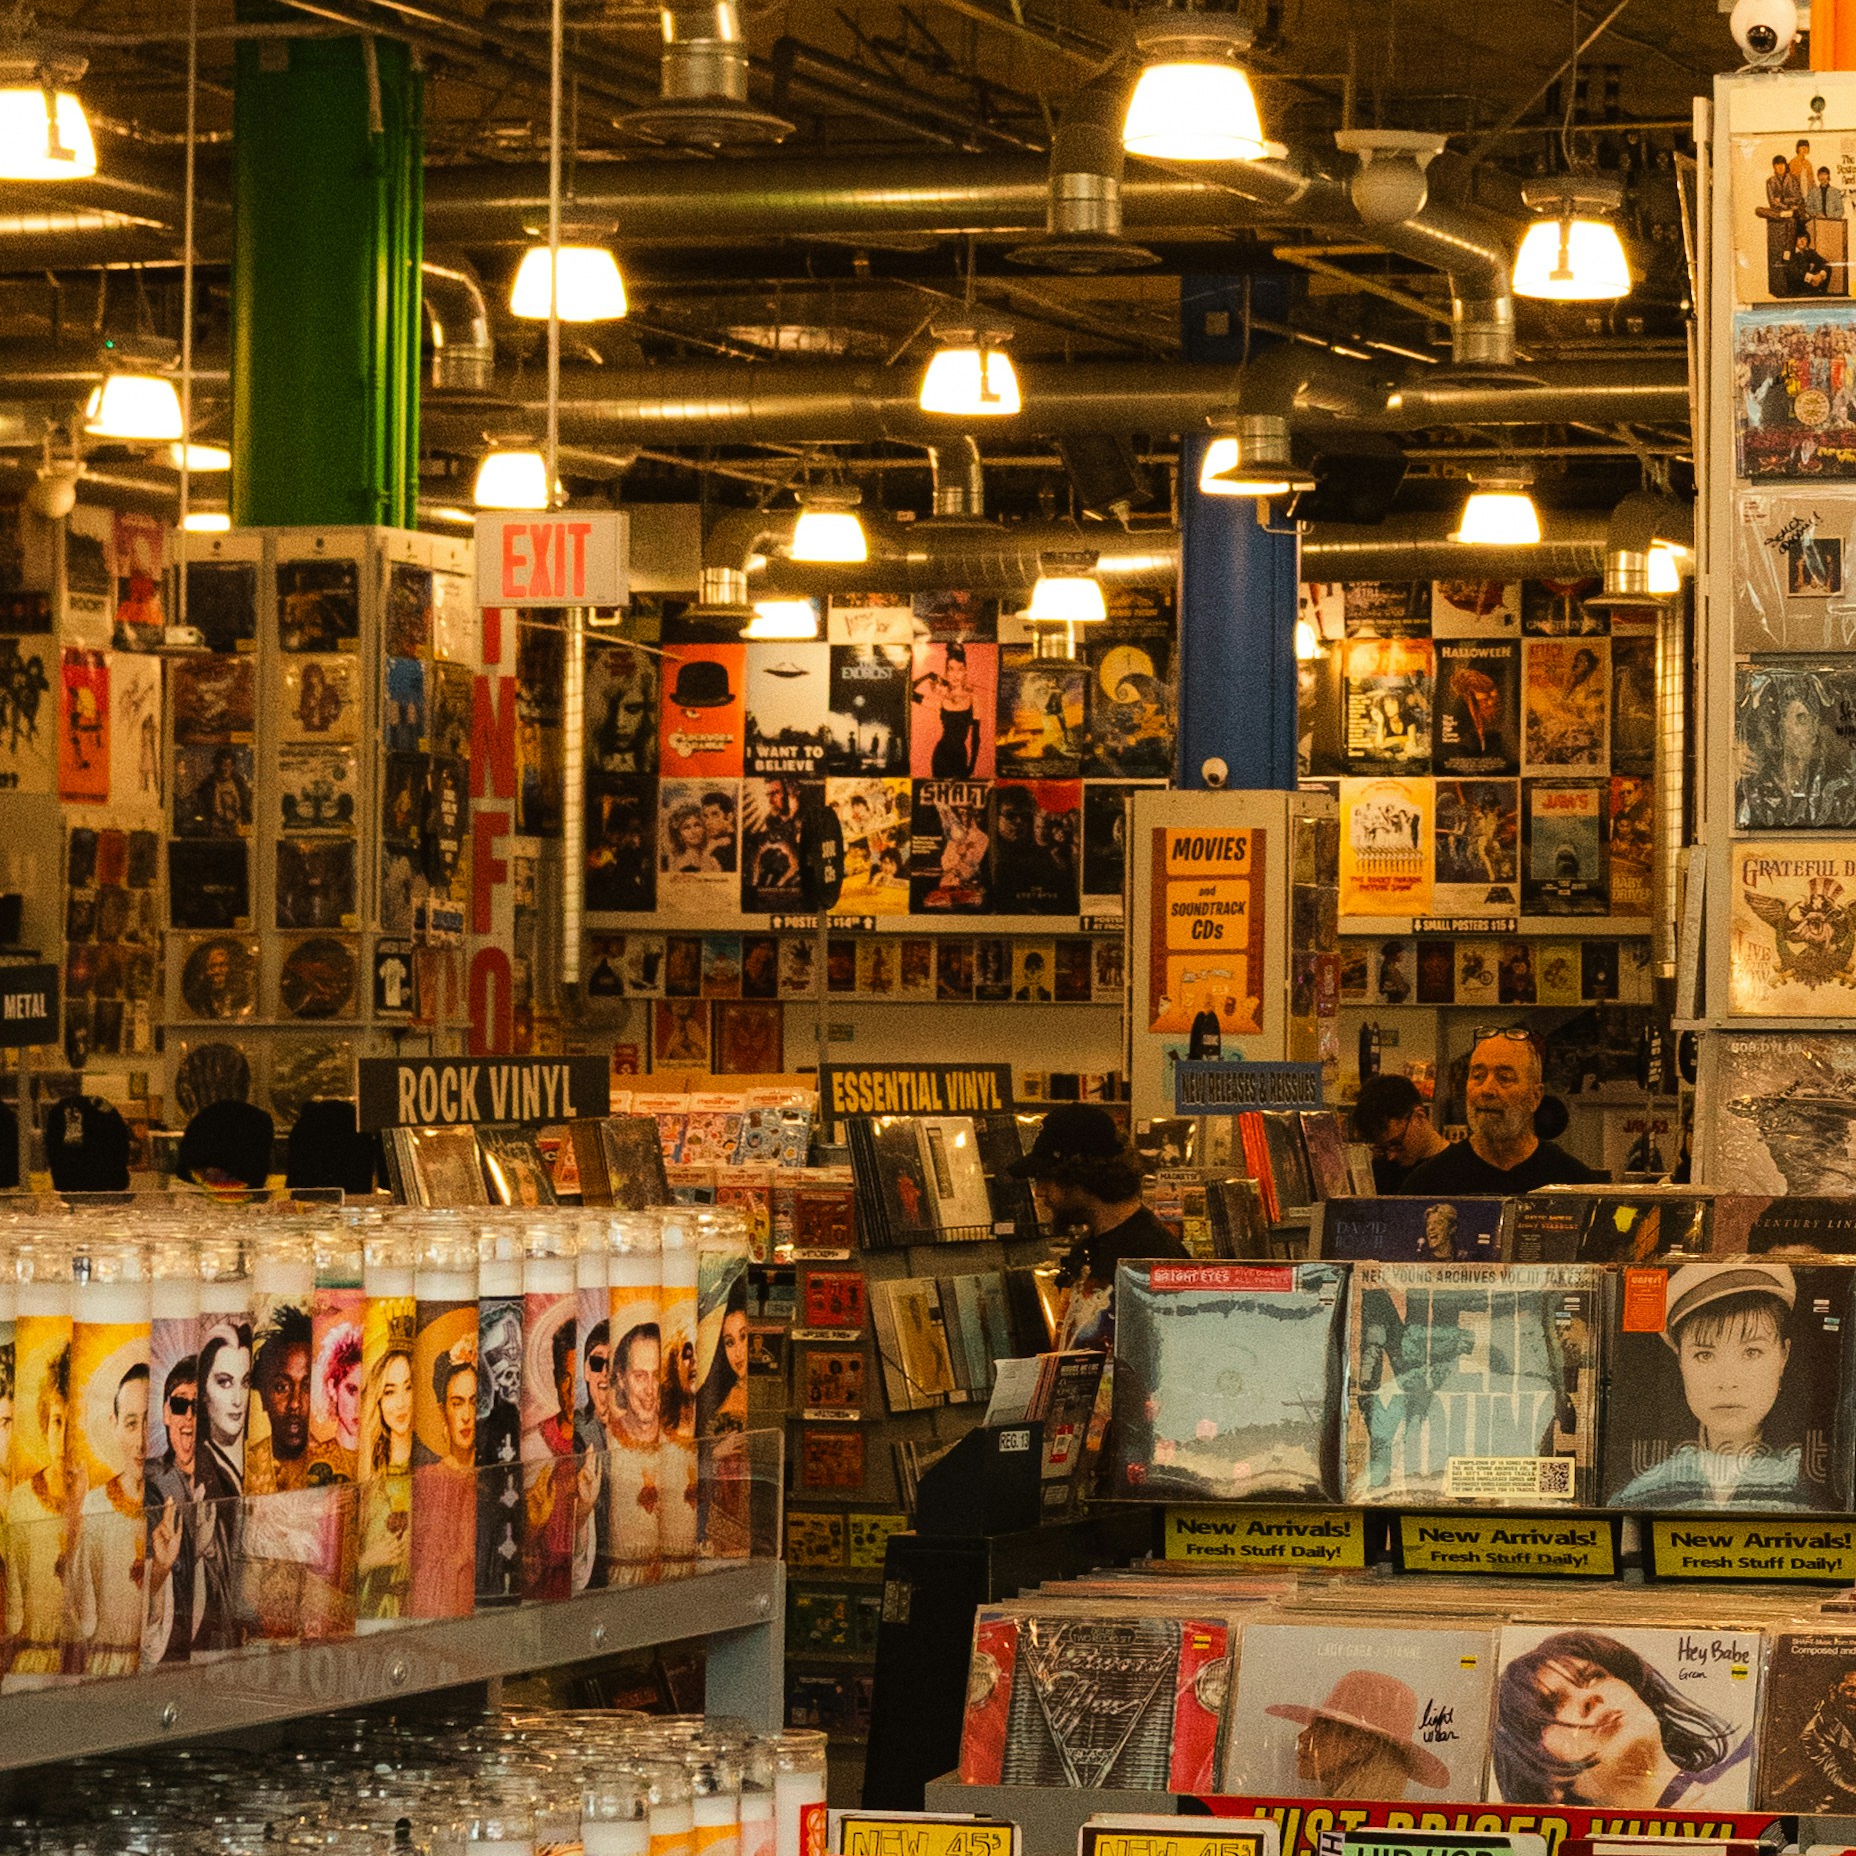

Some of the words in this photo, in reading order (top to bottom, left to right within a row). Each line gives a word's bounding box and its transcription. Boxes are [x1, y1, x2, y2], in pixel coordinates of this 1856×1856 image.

[502, 522, 592, 598] EXIT
[1441, 646, 1513, 659] HALLOWEEN
[755, 746, 798, 758] WANT
[803, 746, 824, 758] TO
[755, 759, 815, 772] BELIEVE
[920, 782, 989, 806] SHAFT
[1540, 794, 1590, 810] JAWS
[1172, 836, 1247, 862] MOVIES
[1743, 858, 1838, 888] GRATEFUL
[1171, 901, 1246, 917] SOUNDTRACK
[1191, 919, 1224, 941] CDs
[3, 992, 46, 1020] METAL
[399, 1066, 480, 1125] ROCK
[486, 1064, 577, 1119] VINYL
[832, 1070, 942, 1113] ESSENTIAL
[945, 1070, 1002, 1110] VINYL
[1754, 1218, 1820, 1230] CENTURY
[1154, 1270, 1198, 1284] BRIGHT
[1201, 1270, 1231, 1283] EYES
[1175, 1518, 1236, 1537] New
[1245, 1518, 1352, 1538] Arrivals!
[1418, 1526, 1476, 1545] New
[1491, 1528, 1597, 1547] Arrivals!
[1670, 1530, 1732, 1548] New
[1743, 1531, 1852, 1550] Arrivals!
[1186, 1543, 1234, 1558] Fresh
[1236, 1543, 1277, 1558] Stuff
[1281, 1543, 1342, 1561] Daily!
[1430, 1550, 1480, 1563] Fresh
[1484, 1550, 1528, 1566] Stuff
[1532, 1551, 1589, 1569] Daily!
[1682, 1555, 1733, 1569] Fresh
[1737, 1556, 1785, 1570] Stuff
[1791, 1557, 1843, 1573] Daily!
[1678, 1636, 1708, 1666] Hey
[1710, 1639, 1750, 1664] Babe
